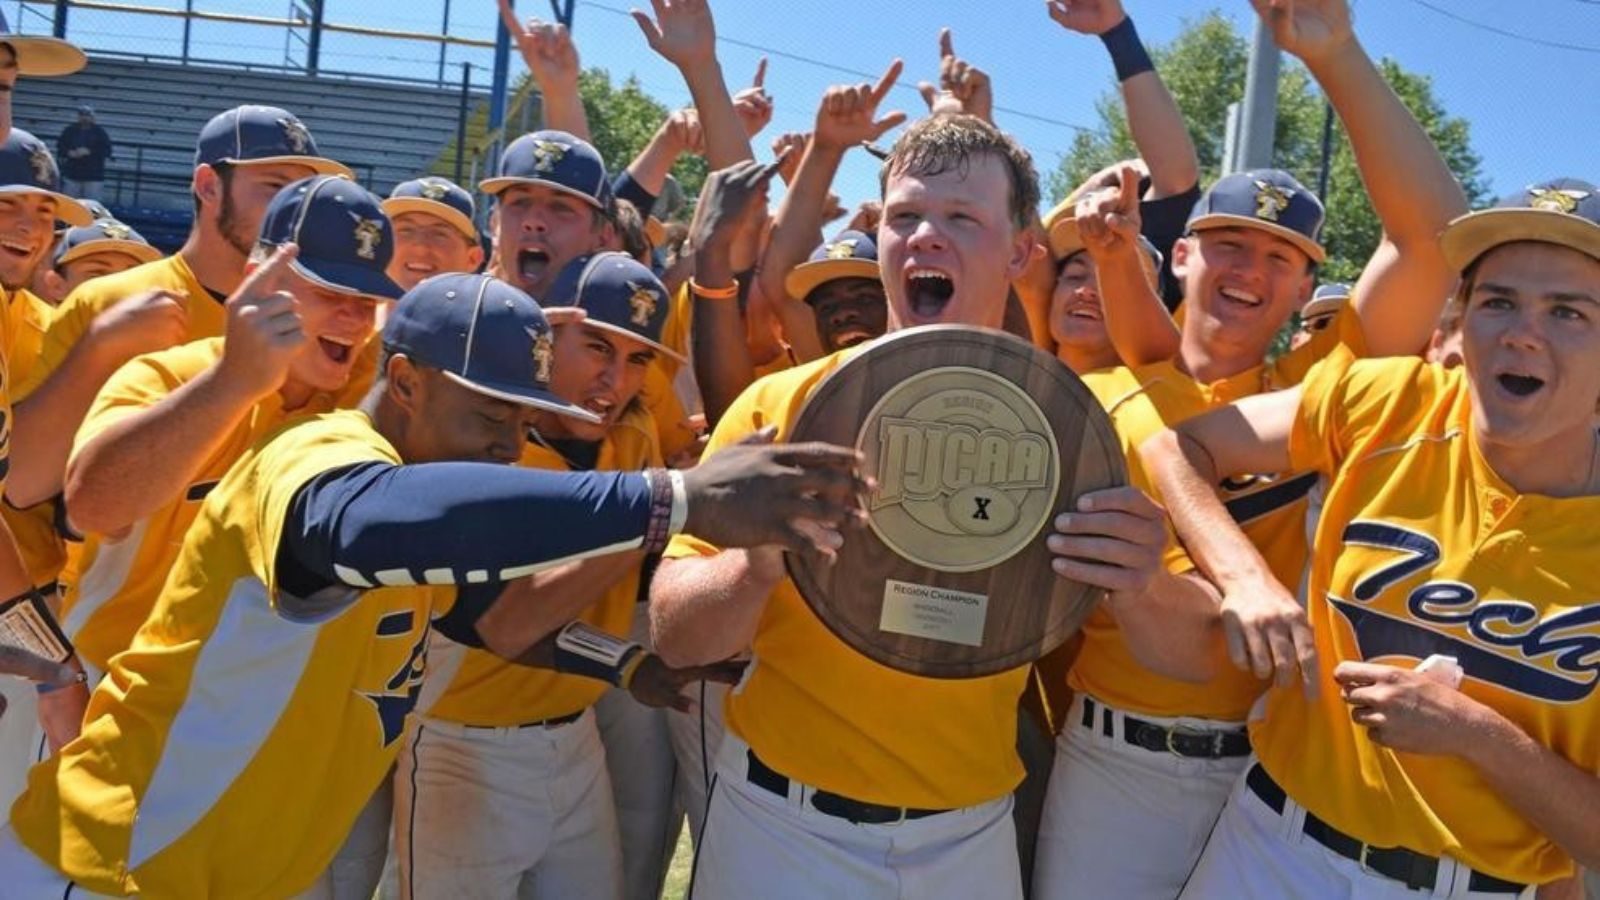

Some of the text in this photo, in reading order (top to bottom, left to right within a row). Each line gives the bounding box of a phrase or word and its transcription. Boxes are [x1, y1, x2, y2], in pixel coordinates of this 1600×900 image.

[874, 420, 1048, 508] NJCAA
[972, 497, 992, 520] X
[1340, 519, 1600, 678] Tech
